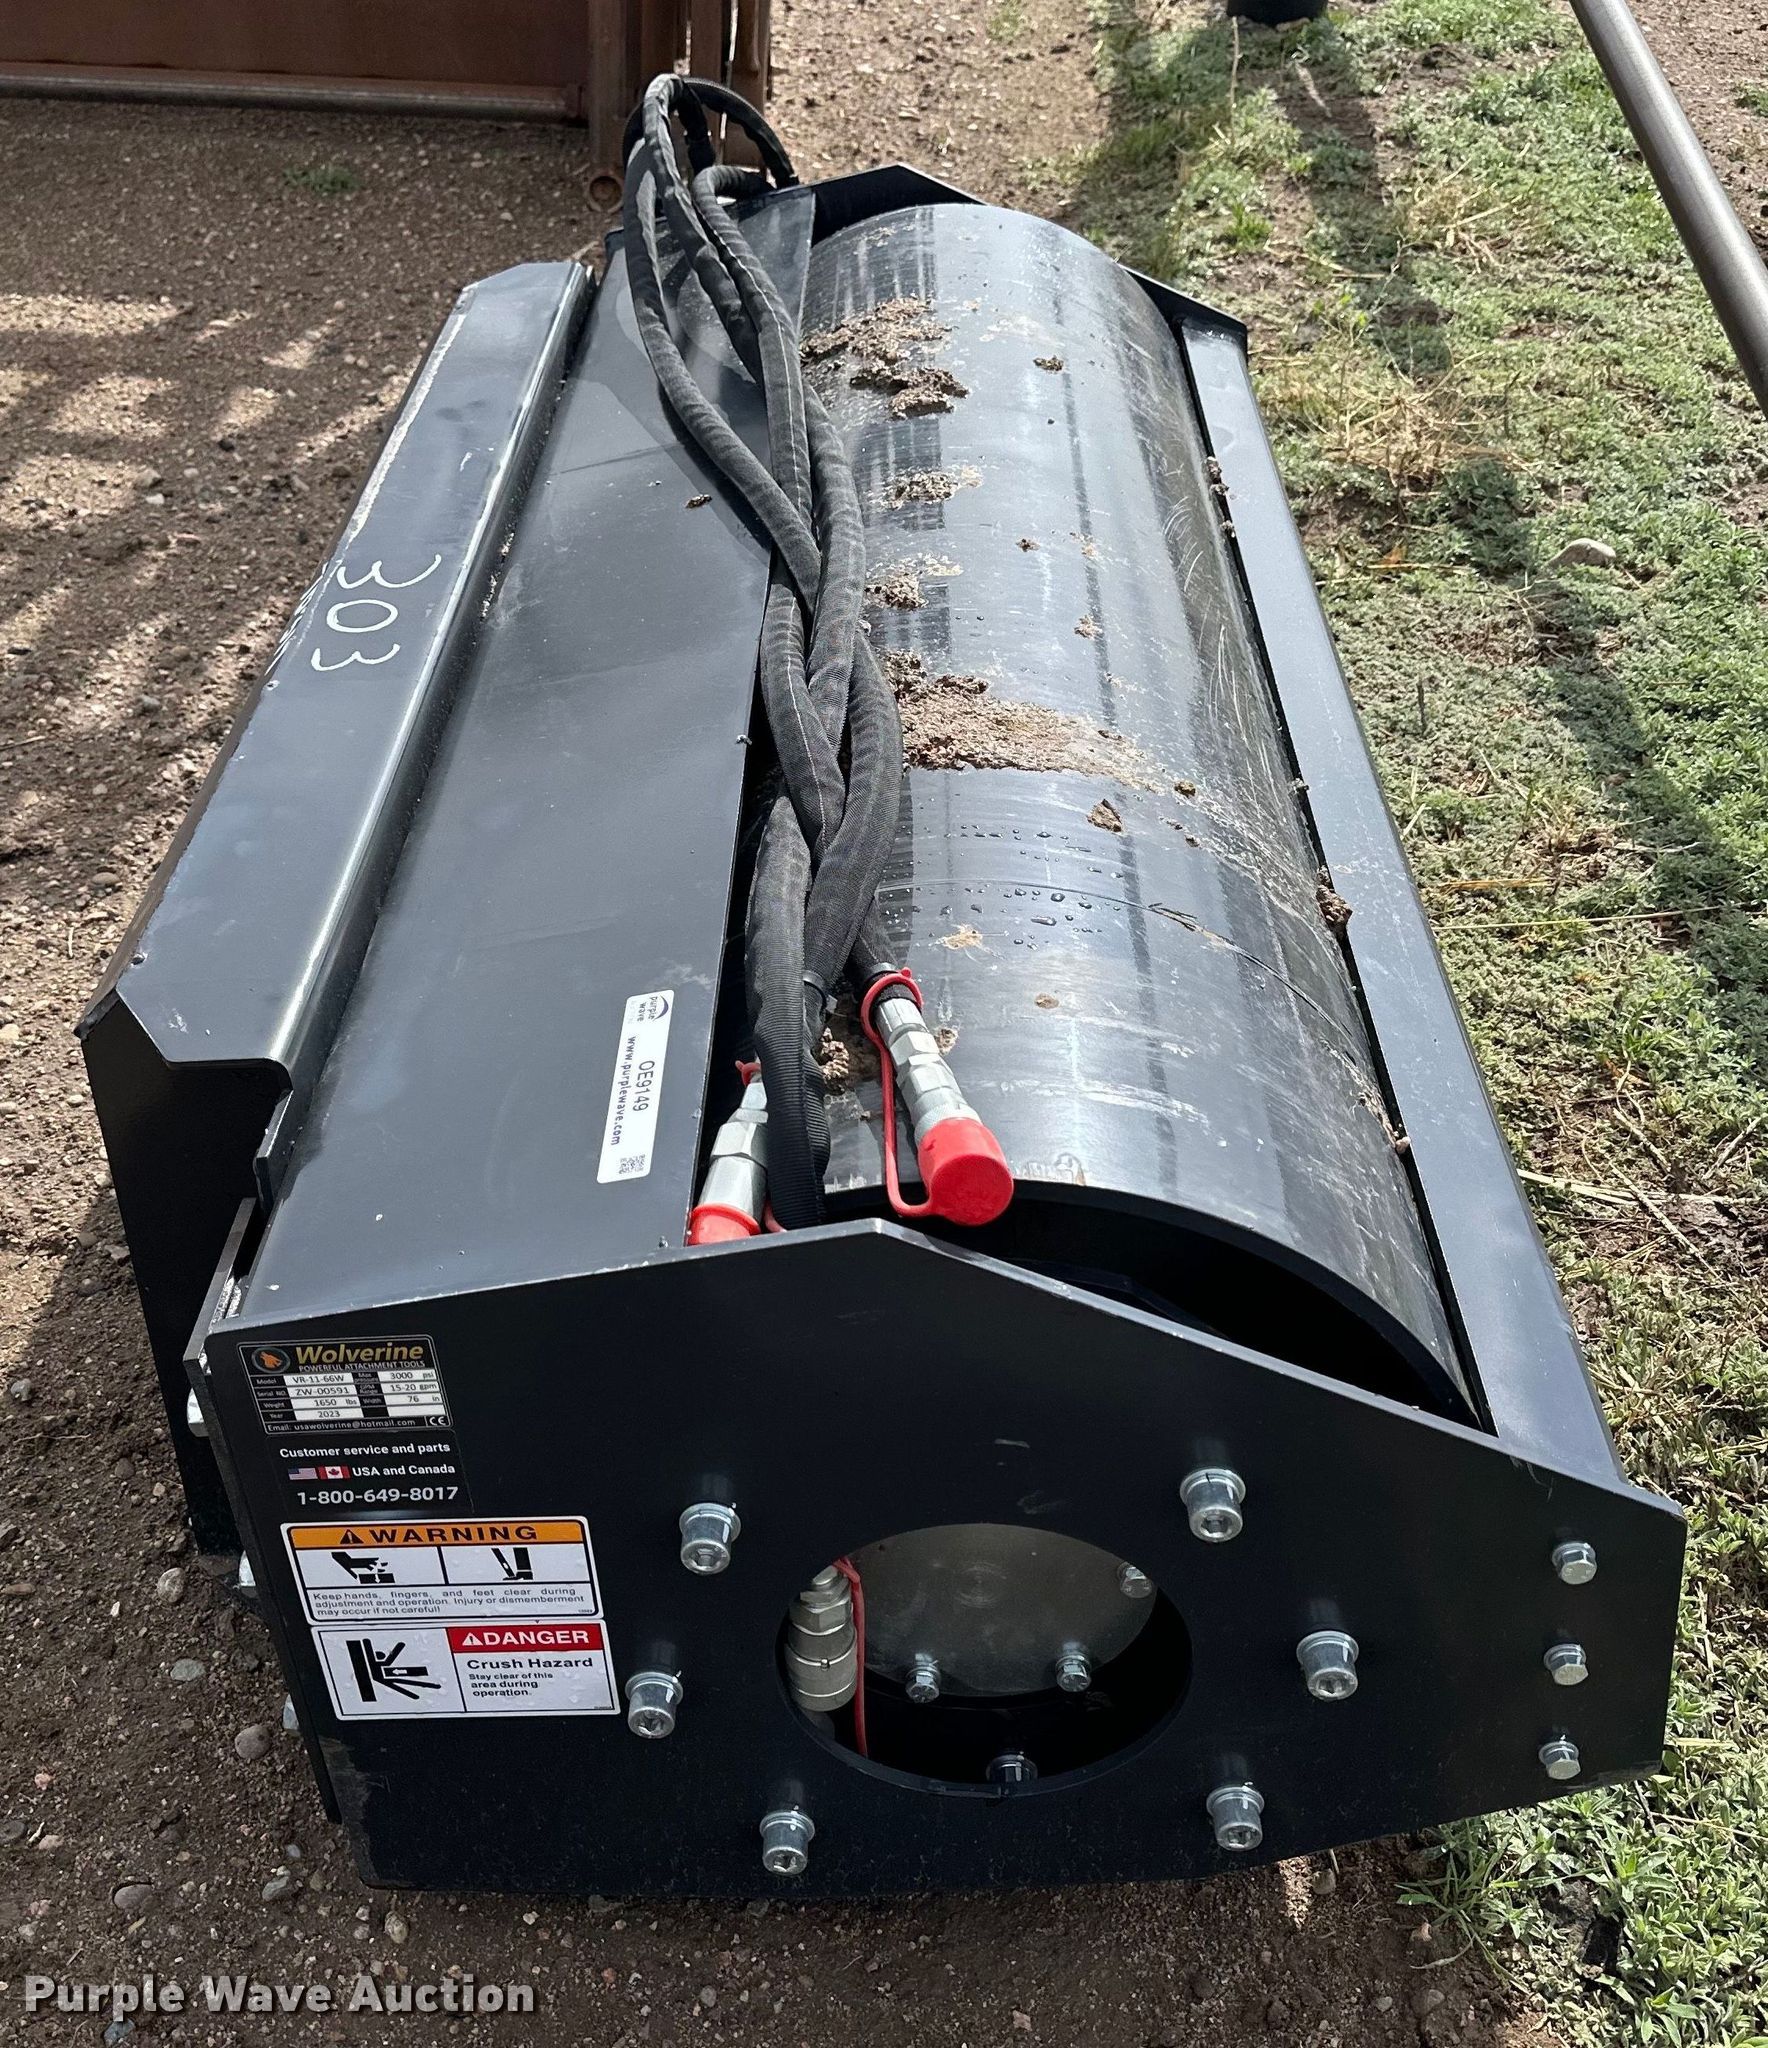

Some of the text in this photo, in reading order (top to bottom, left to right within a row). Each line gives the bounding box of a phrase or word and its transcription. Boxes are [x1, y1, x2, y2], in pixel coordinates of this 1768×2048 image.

[310, 553, 442, 672] 303
[637, 1002, 647, 1022] wave
[611, 1036, 636, 1146] www.purplewave.com
[295, 1342, 424, 1364] Wolverine
[298, 1360, 426, 1372] POWERFUL ATTACHMENT TOOLS
[292, 1375, 345, 1384] VR-11-66W
[390, 1371, 435, 1380] 3000 psi
[295, 1386, 350, 1396] ZW-00591
[390, 1383, 438, 1392] 15-20 gpm
[314, 1398, 358, 1407] 1650 lbs
[407, 1395, 420, 1403] 76
[317, 1410, 341, 1418] 2023
[294, 1419, 416, 1430] usawolverine@hotmail.com
[429, 1416, 446, 1426] CE
[279, 1443, 451, 1458] Customer service and parts
[352, 1463, 456, 1477] USA and Canada
[297, 1486, 459, 1505] 1-800-649-8017
[369, 1525, 538, 1543] WARNING
[540, 1587, 576, 1596] during
[315, 1600, 373, 1608] adjustment
[454, 1597, 484, 1605] Injury
[498, 1595, 585, 1604] dismemberment
[341, 1607, 371, 1615] occur
[483, 1630, 589, 1646] DANGER
[467, 1657, 594, 1670] Crush Hazard
[468, 1673, 492, 1681] Stay
[493, 1672, 520, 1680] clear
[499, 1680, 539, 1689] during
